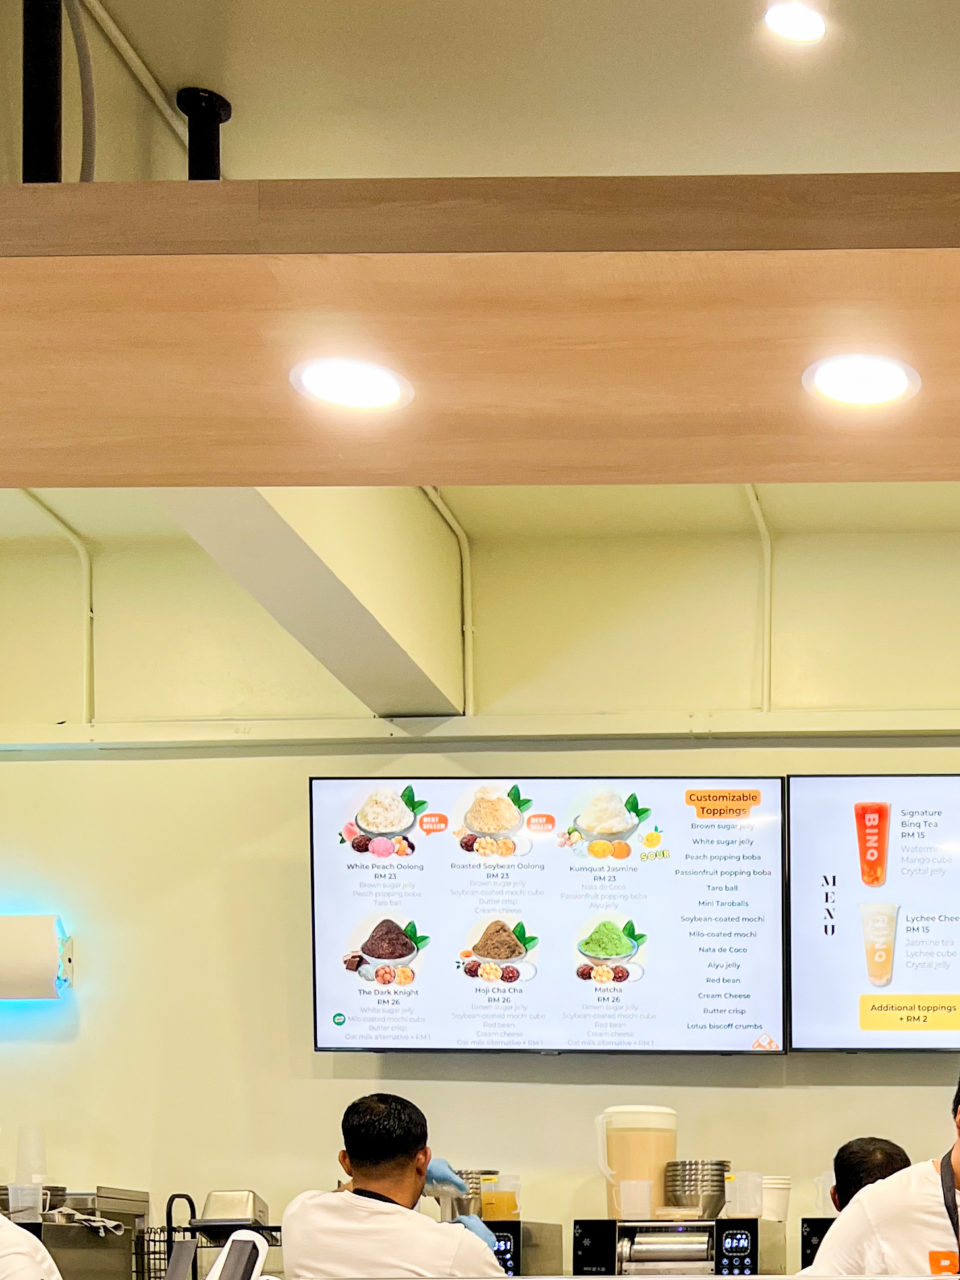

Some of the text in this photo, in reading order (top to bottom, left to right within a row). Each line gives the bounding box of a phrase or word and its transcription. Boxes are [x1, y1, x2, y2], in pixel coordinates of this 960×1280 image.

[689, 793, 757, 802] Customizable
[701, 806, 747, 817] Toppings
[901, 809, 942, 818] Signature
[865, 813, 879, 861] BINQ
[640, 850, 670, 861] SOUR
[821, 875, 836, 936] MENU
[906, 915, 935, 923] Lychee
[918, 1005, 956, 1013] toppings
